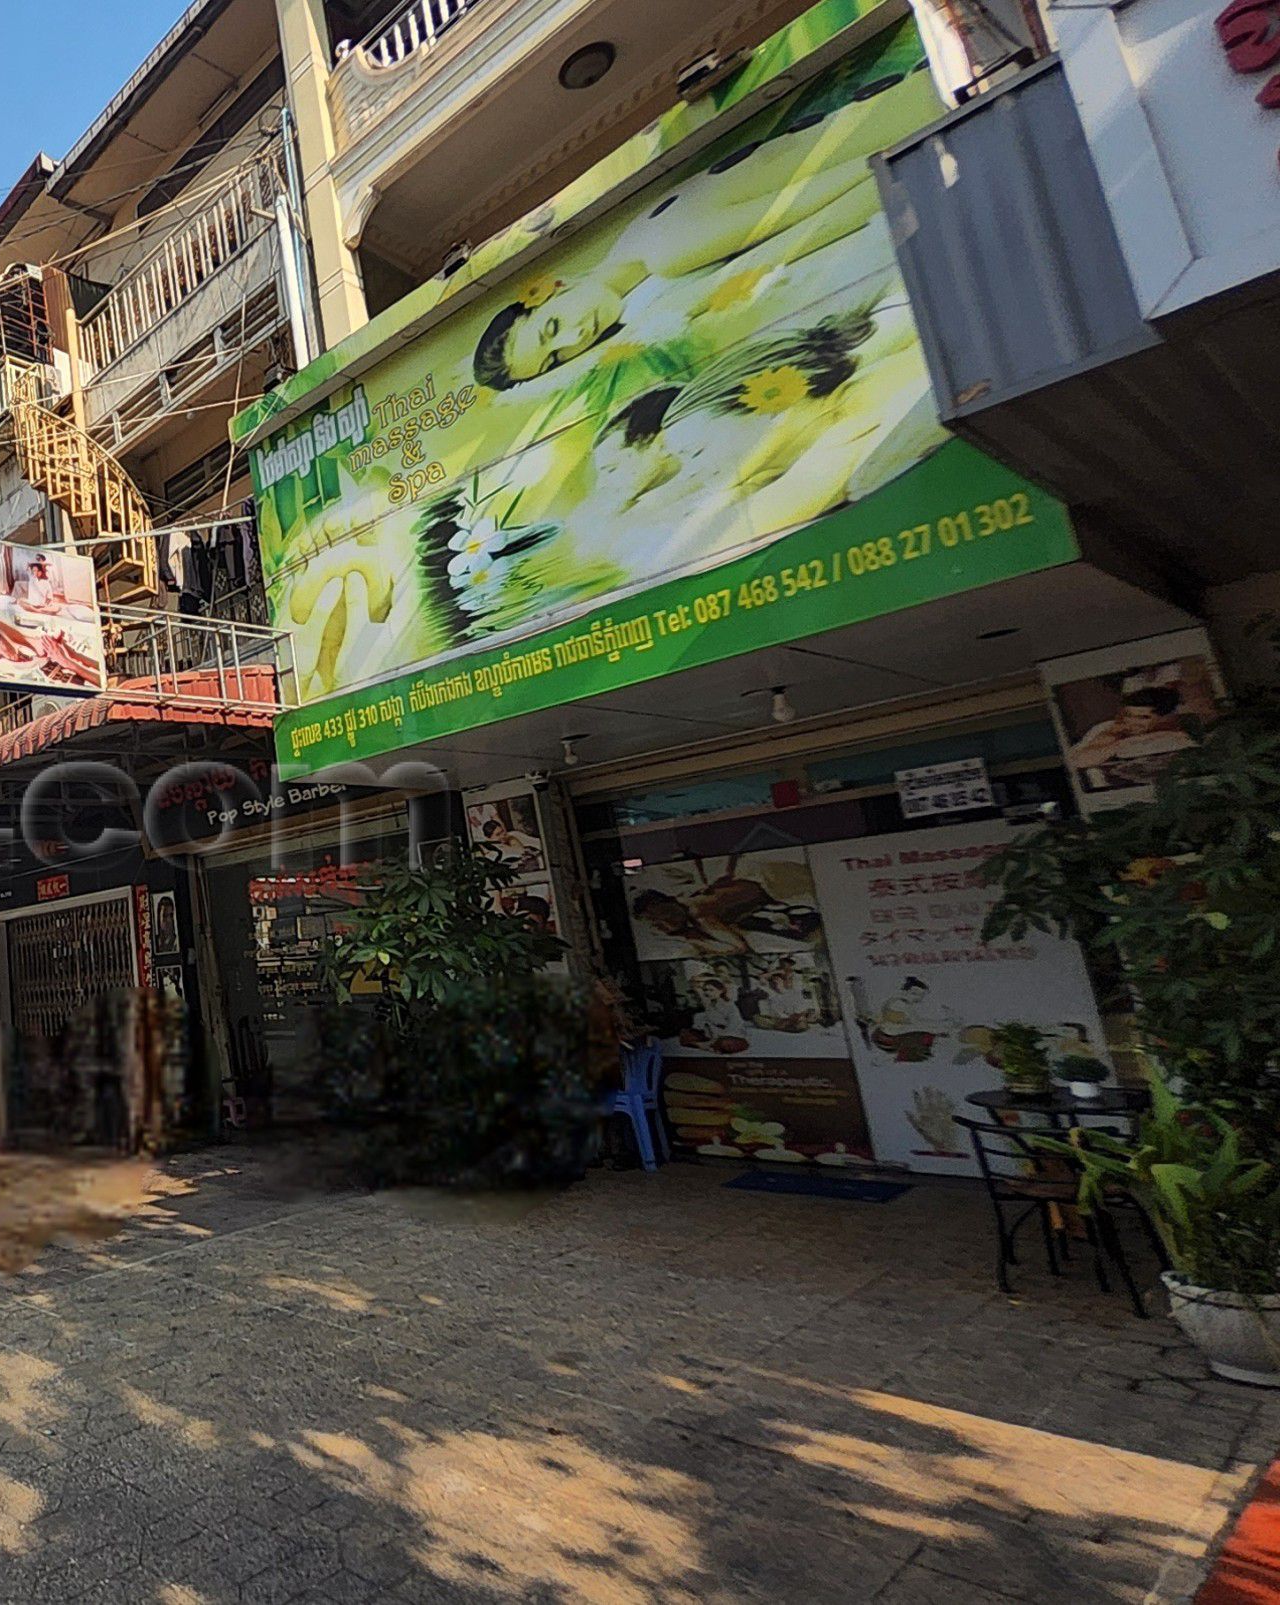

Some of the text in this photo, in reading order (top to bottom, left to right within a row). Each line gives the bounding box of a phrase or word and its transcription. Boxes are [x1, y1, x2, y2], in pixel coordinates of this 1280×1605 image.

[372, 373, 437, 428] Thai
[348, 384, 477, 473] massage
[402, 439, 426, 469] &
[388, 461, 446, 503] Spa
[324, 716, 343, 739] 433
[358, 705, 377, 728] 310
[653, 605, 692, 636] Tel:
[694, 589, 731, 624] 087
[738, 575, 779, 609] 468
[780, 560, 828, 597] 542
[832, 552, 842, 583] /
[847, 537, 897, 575] 088
[898, 524, 932, 560] 27
[937, 511, 974, 547] 01
[975, 493, 1034, 536] 302
[207, 807, 239, 828] Pop
[242, 794, 285, 819] Style
